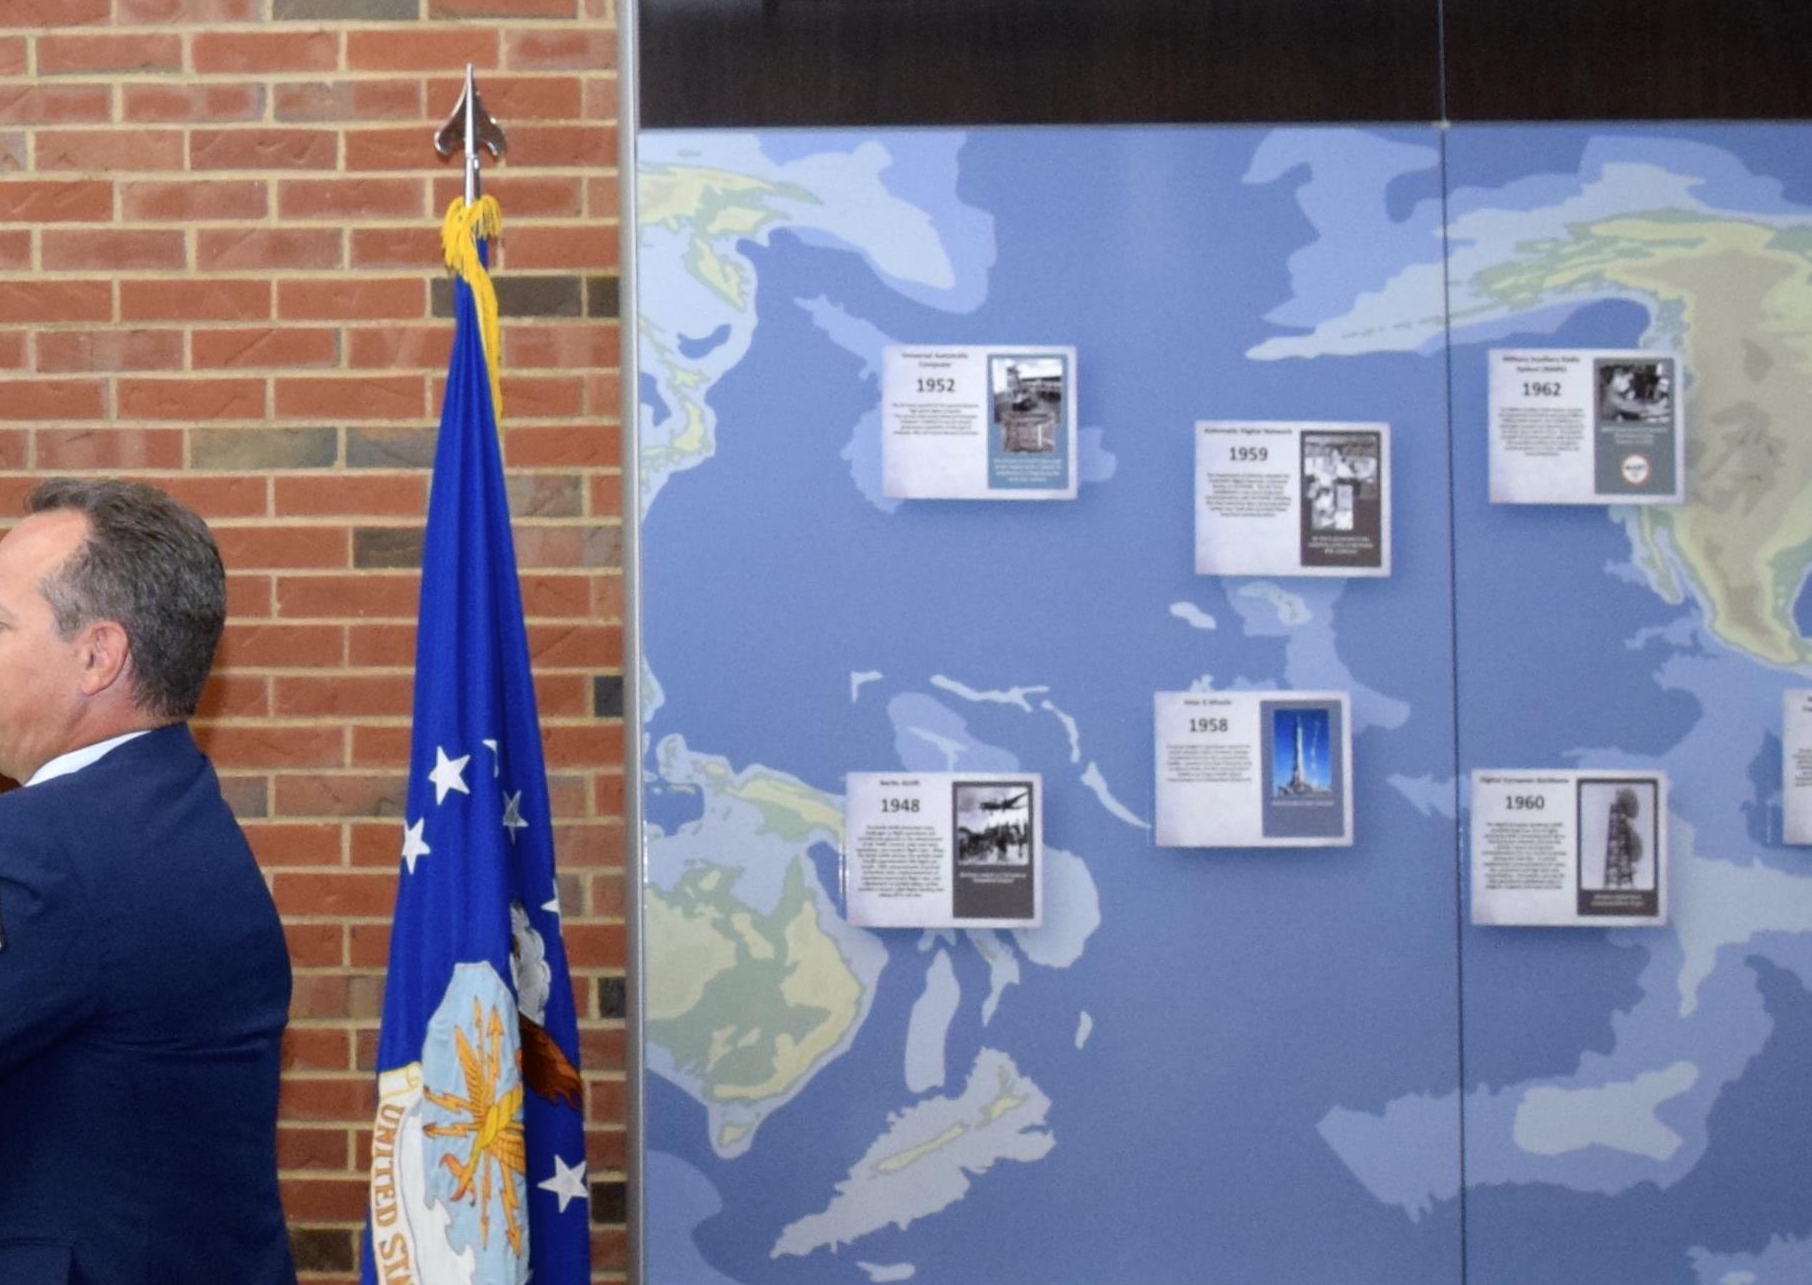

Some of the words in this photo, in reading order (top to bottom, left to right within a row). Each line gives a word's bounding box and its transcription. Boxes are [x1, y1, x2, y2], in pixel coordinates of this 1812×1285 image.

[916, 377, 957, 393] 1952
[1523, 381, 1563, 397] 1962
[1229, 446, 1269, 462] 1959
[1189, 717, 1229, 733] 1958
[880, 797, 921, 814] 1948
[1505, 794, 1546, 811] 1960
[373, 1103, 405, 1229] UNITED
